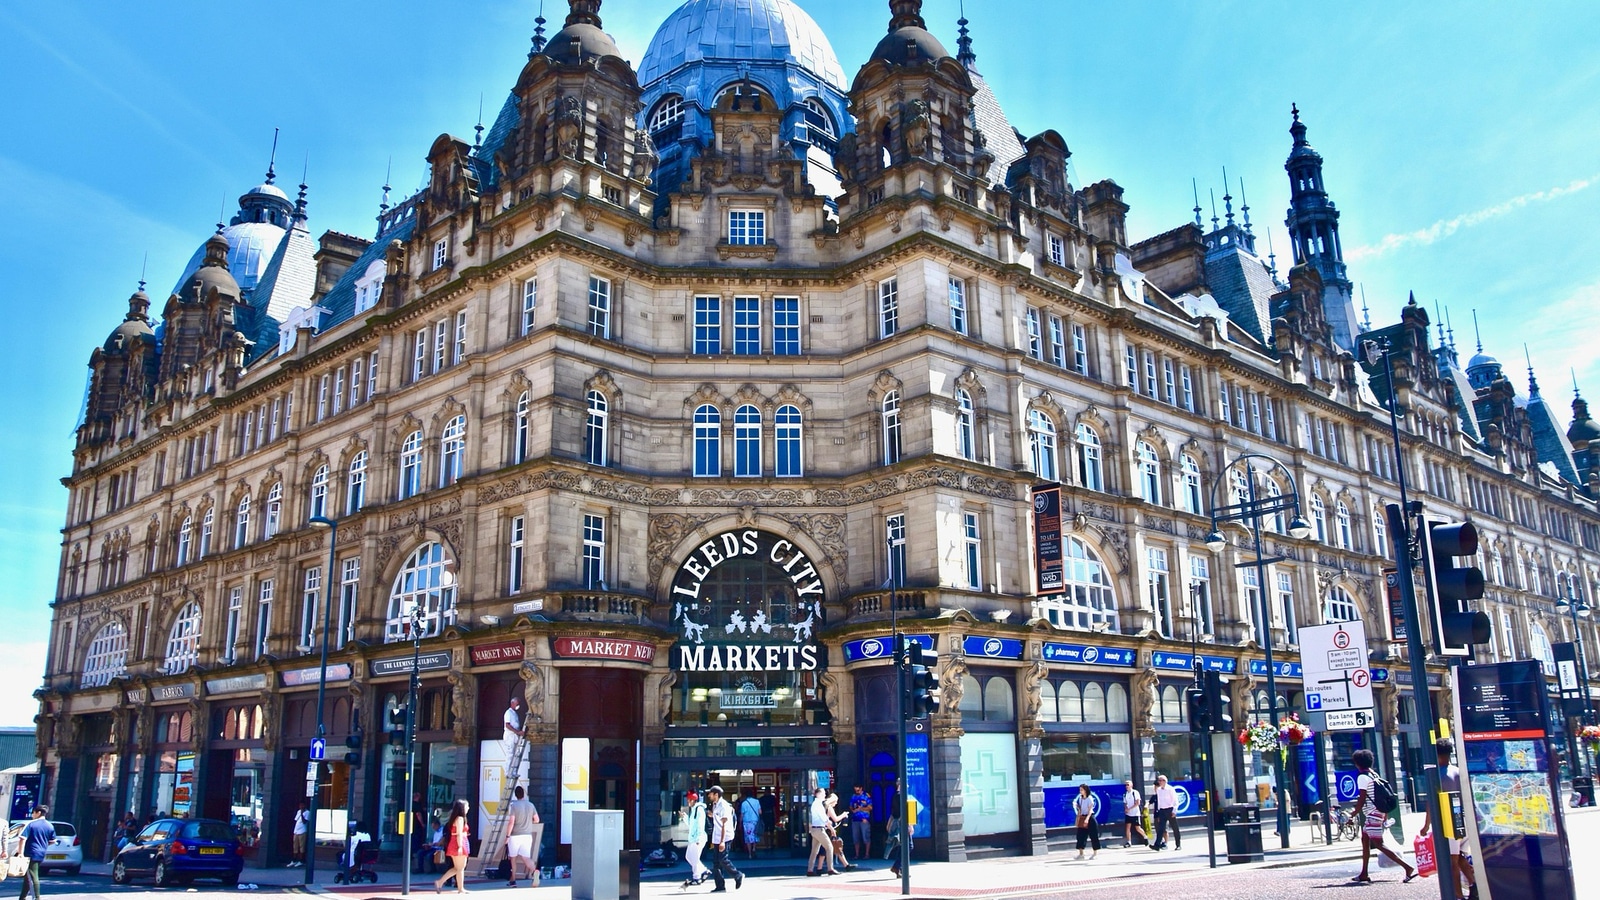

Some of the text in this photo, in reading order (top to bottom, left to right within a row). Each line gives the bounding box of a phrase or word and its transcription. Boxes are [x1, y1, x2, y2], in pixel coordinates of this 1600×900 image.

[673, 530, 824, 598] LEEDS CITY
[475, 646, 522, 660] MARKET NEWS
[570, 641, 631, 656] MARKET
[1055, 648, 1080, 658] pharmacy
[1104, 652, 1120, 661] beauty
[417, 657, 439, 665] UILDING
[680, 645, 817, 671] MARKETS
[1166, 658, 1186, 666] pharmacy
[724, 695, 774, 705] KIRKGATE
[1310, 695, 1319, 708] P
[1416, 853, 1433, 865] SALE
